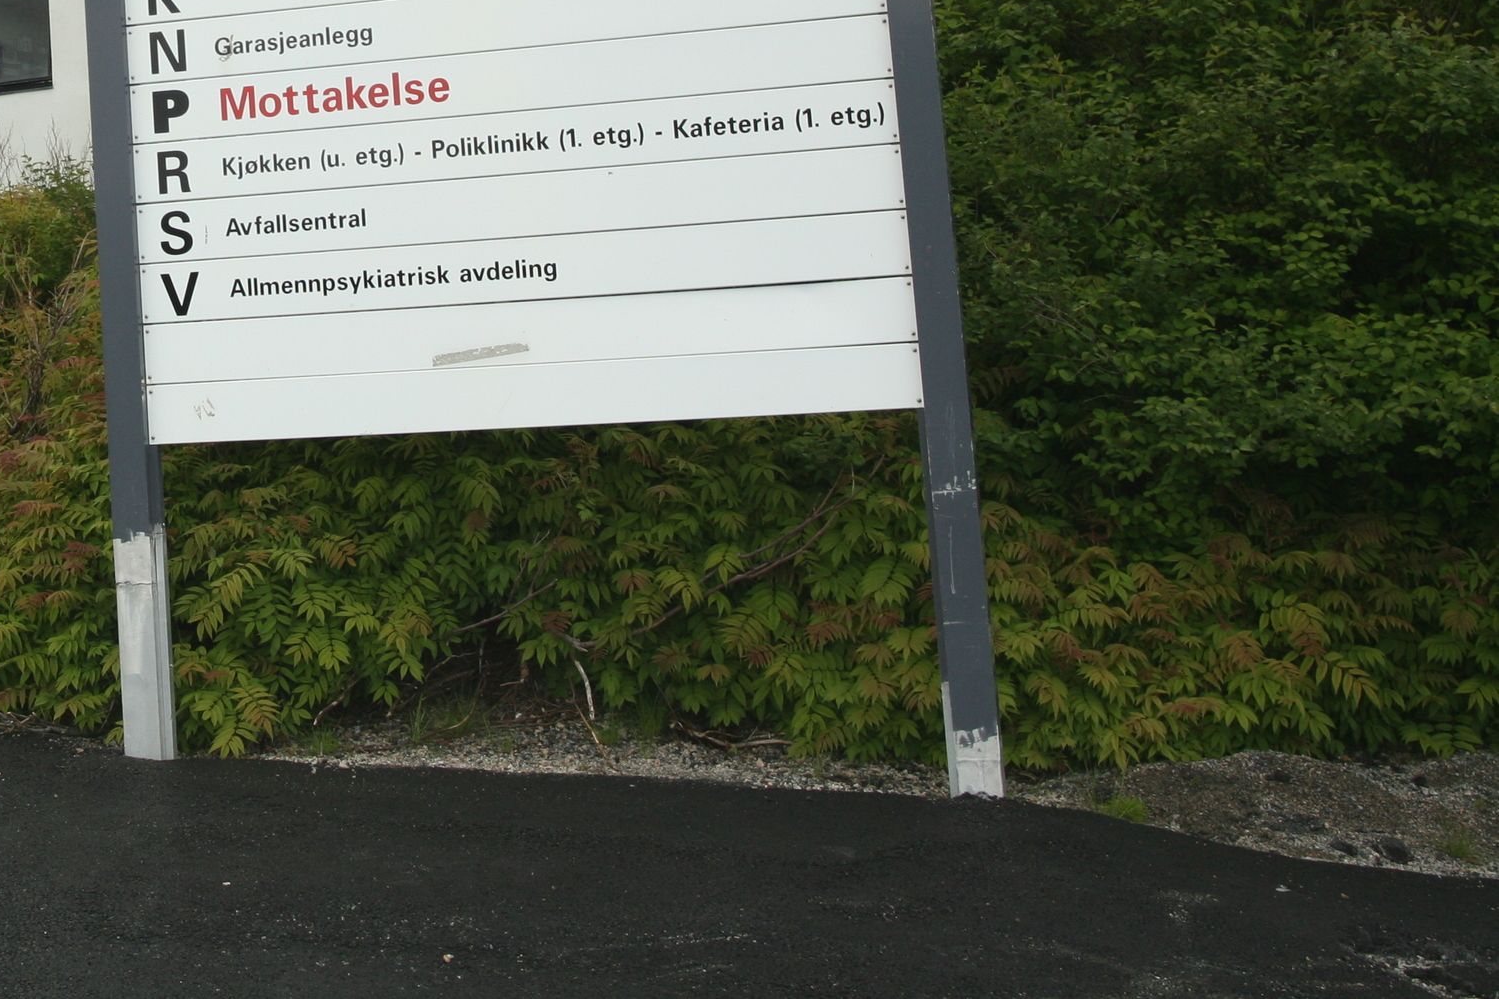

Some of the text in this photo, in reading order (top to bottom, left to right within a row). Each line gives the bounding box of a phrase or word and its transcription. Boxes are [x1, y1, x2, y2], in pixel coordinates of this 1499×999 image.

[149, 29, 187, 75] N
[215, 27, 372, 57] Garasjeanlegg
[152, 90, 189, 134] P
[220, 72, 450, 121] Mottakelse
[222, 153, 310, 180] Kjøkken
[321, 149, 345, 172] (u.
[356, 143, 404, 168] etg.)
[432, 131, 550, 159] Poliklinikk
[560, 128, 582, 152] (1.
[593, 122, 644, 148] etg.)
[673, 112, 784, 139] Kafeteria
[796, 108, 819, 133] (1.
[831, 102, 884, 128] etg.)
[157, 150, 191, 195] R
[160, 210, 193, 255] S
[226, 208, 366, 237] Avfallsentral
[160, 271, 199, 316] V
[230, 259, 557, 298] Allmennpsykiatrisk avdeling
